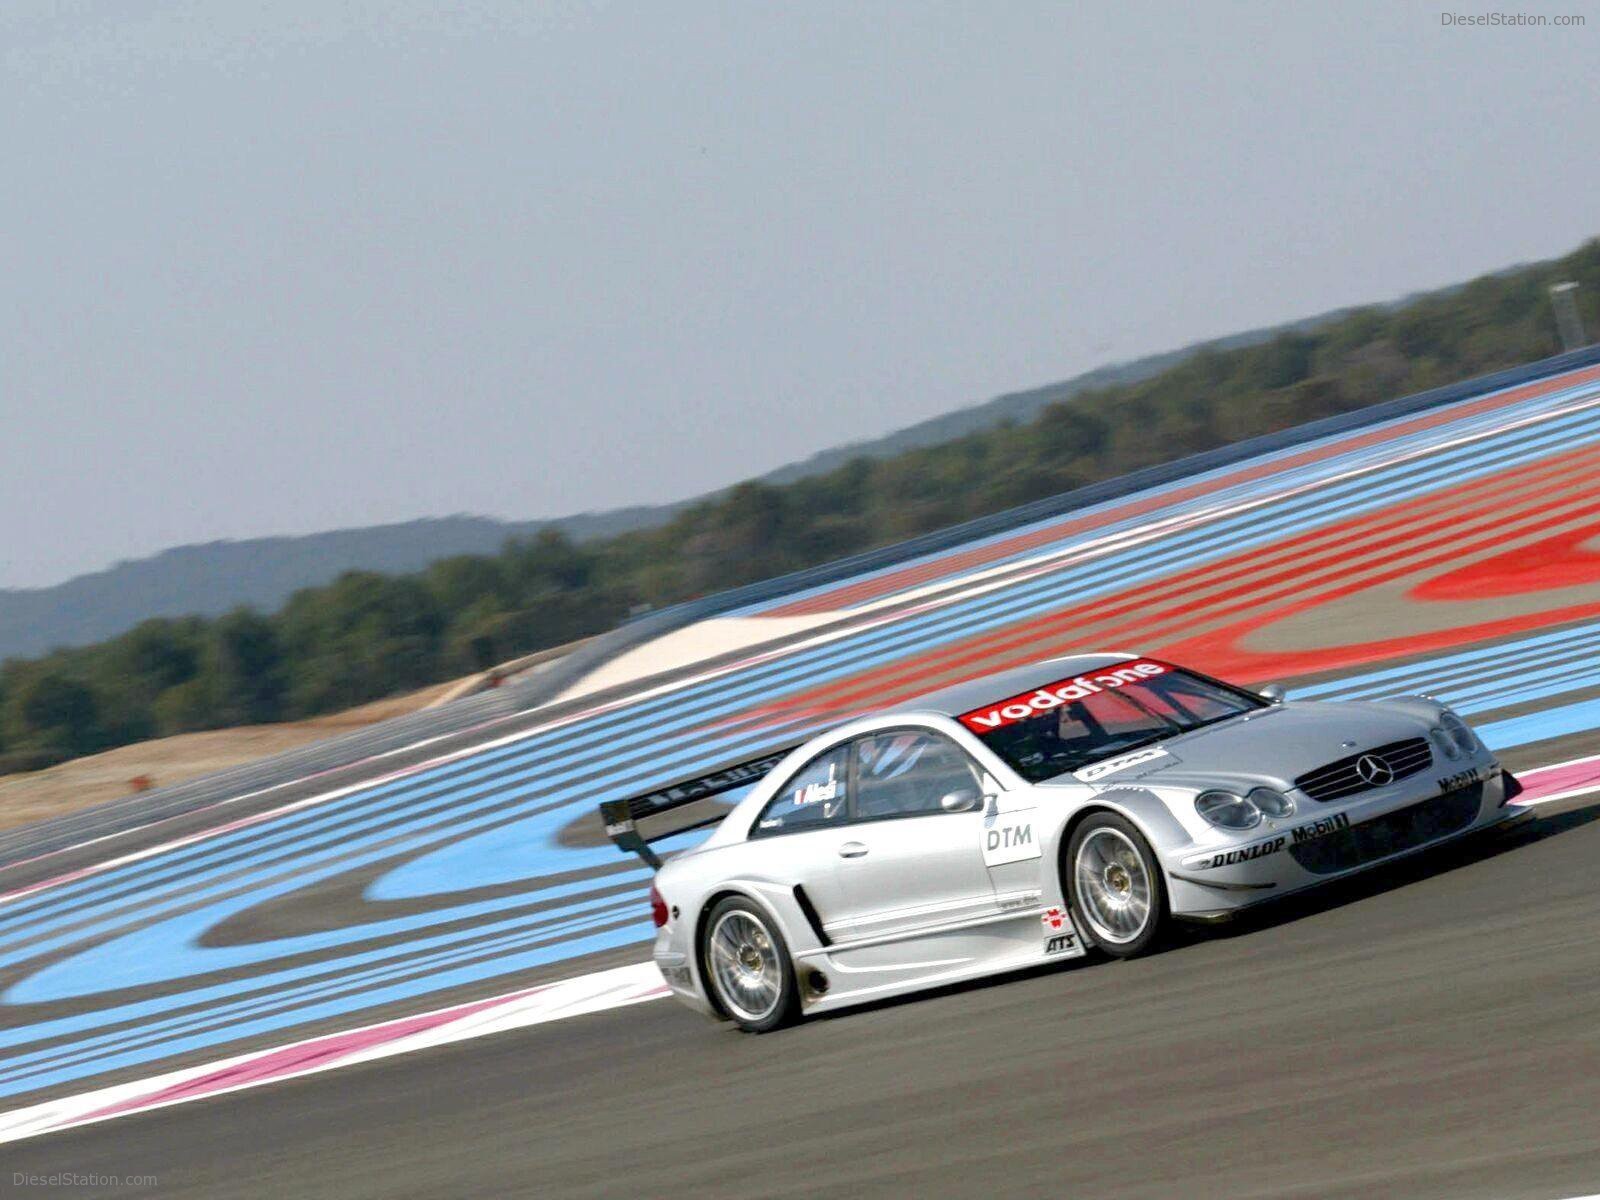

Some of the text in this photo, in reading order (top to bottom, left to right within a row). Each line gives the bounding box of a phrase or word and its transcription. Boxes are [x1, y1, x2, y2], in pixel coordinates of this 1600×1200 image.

[971, 662, 1165, 728] vodafone
[987, 823, 1032, 851] DTM
[1211, 836, 1286, 868] DUNLOP
[1045, 933, 1076, 954] ATS
